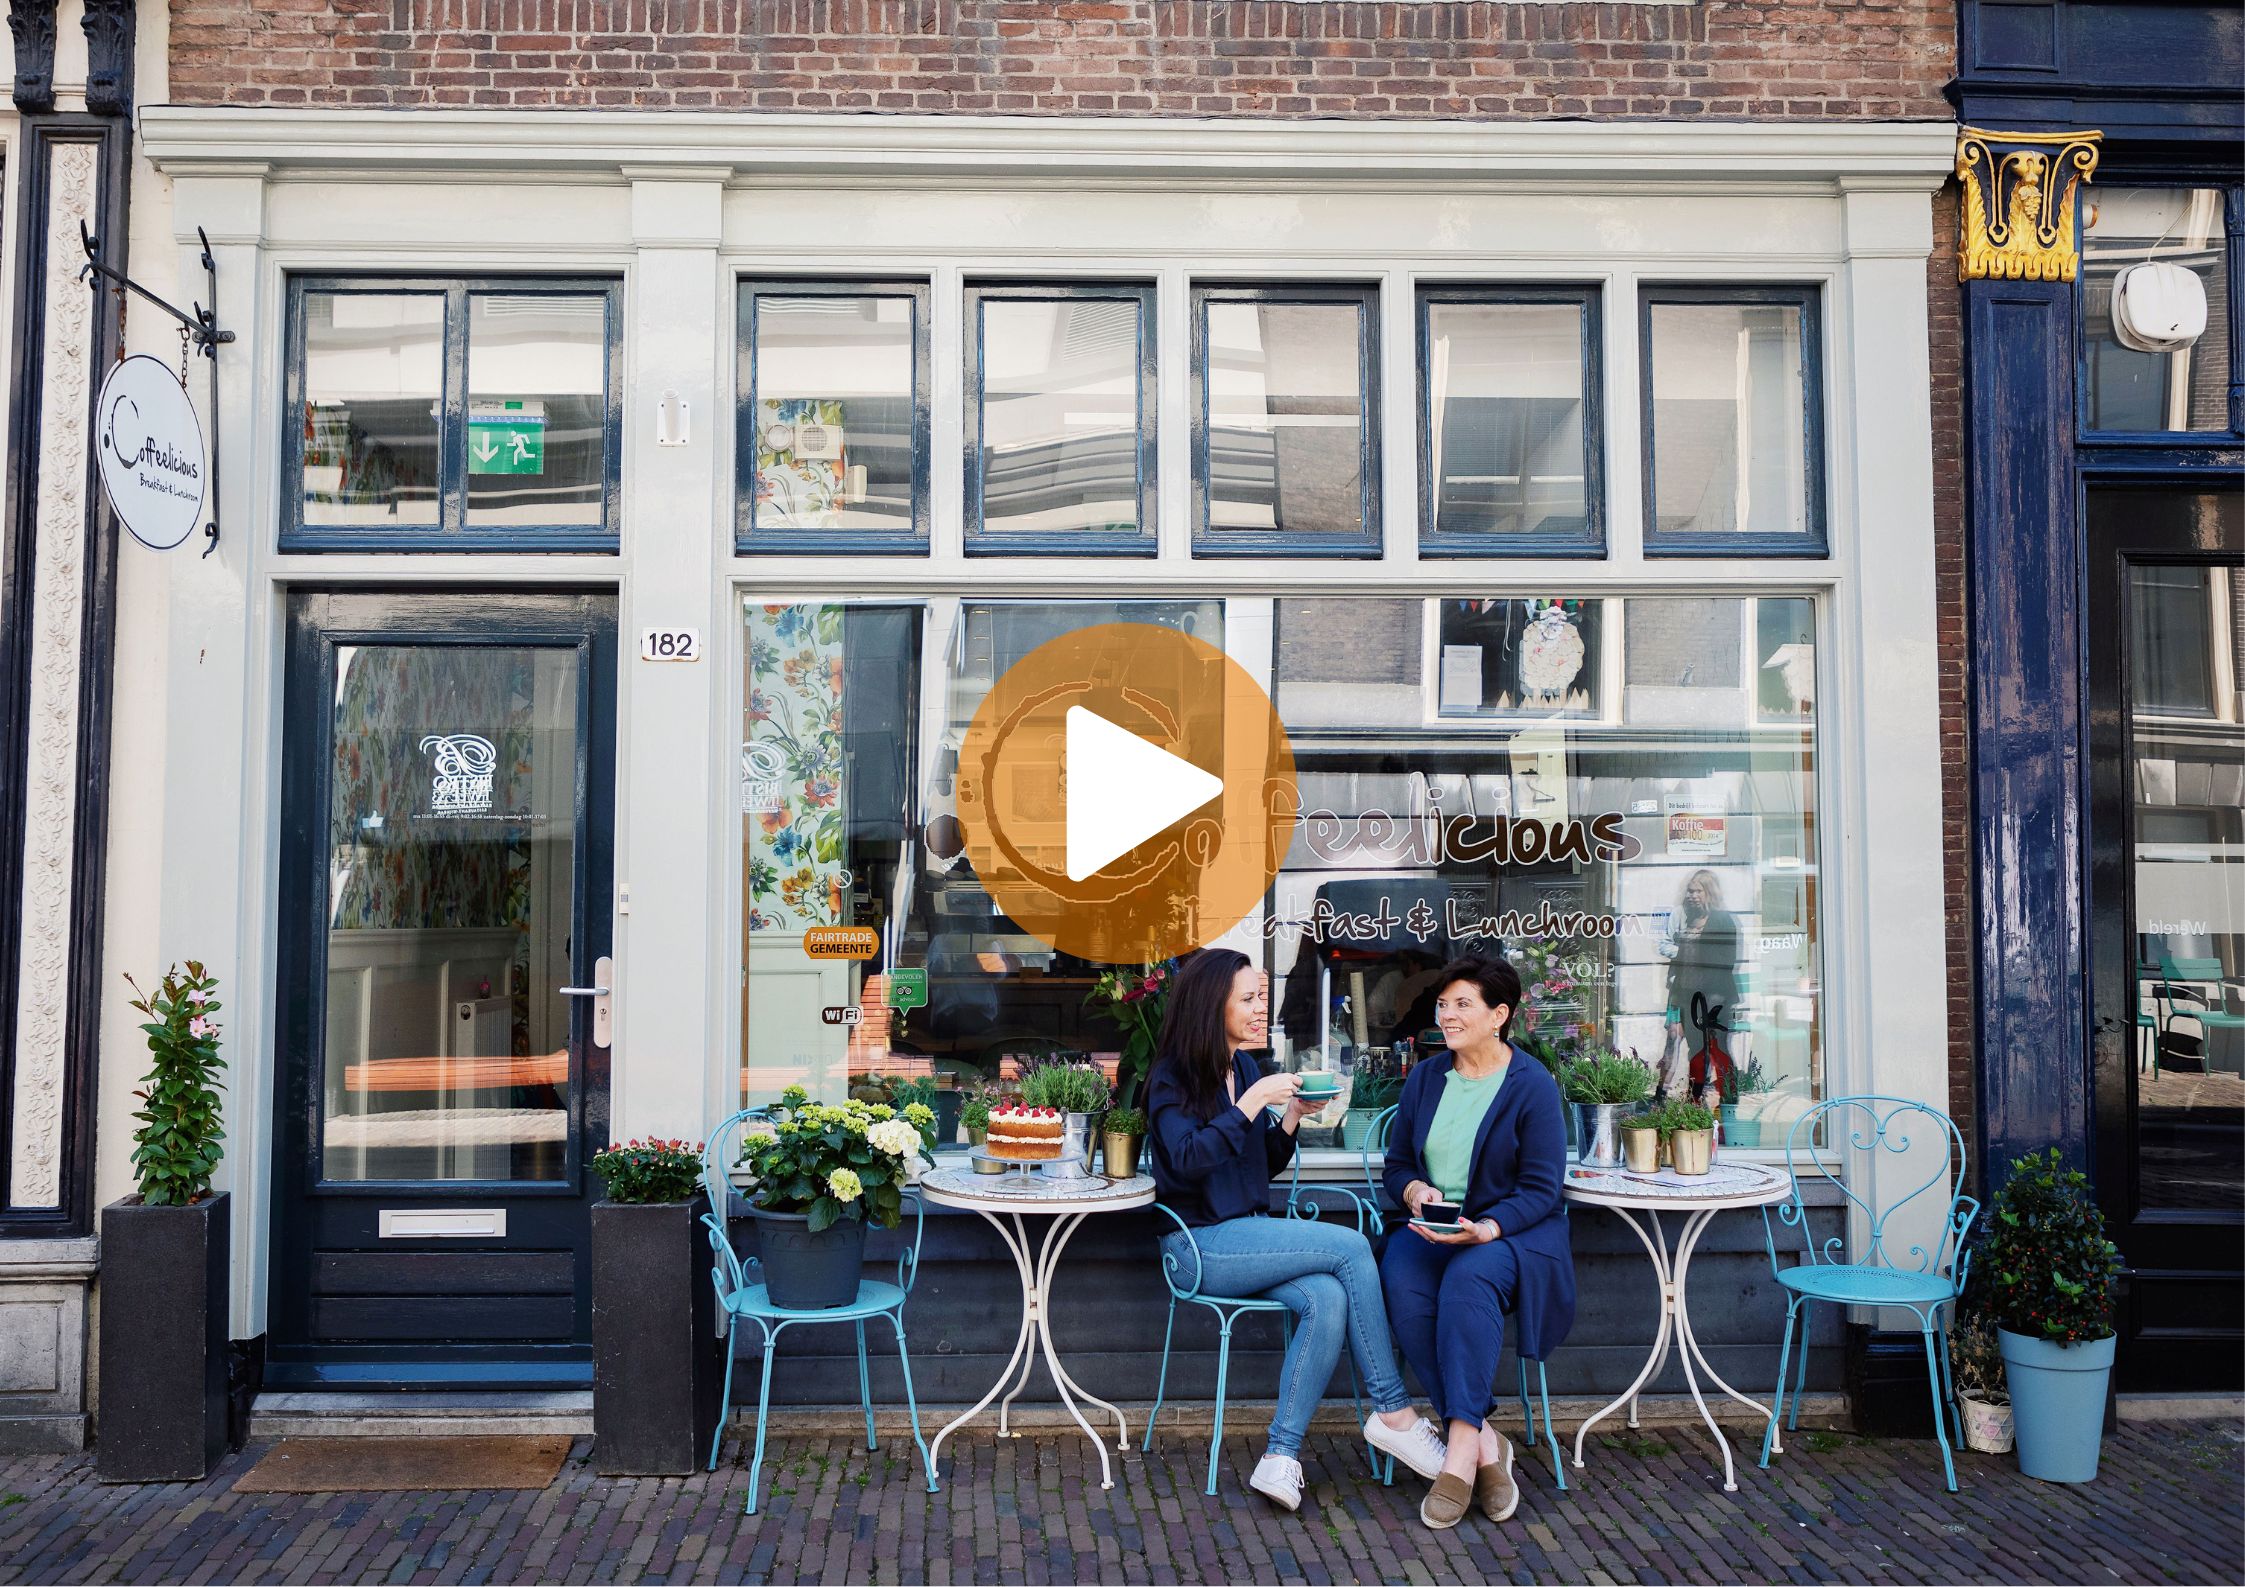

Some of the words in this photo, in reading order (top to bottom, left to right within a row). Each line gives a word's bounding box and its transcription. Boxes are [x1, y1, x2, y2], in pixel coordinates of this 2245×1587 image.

[111, 394, 198, 479] Coffeelicious
[139, 472, 168, 493] Breakfast
[649, 633, 692, 656] 182
[1407, 898, 1438, 943] &
[1447, 900, 1641, 941] Lunchroom
[810, 932, 872, 942] FAIRTRADE
[810, 943, 872, 954] GEMEENTE
[1562, 962, 1615, 978] VOL?
